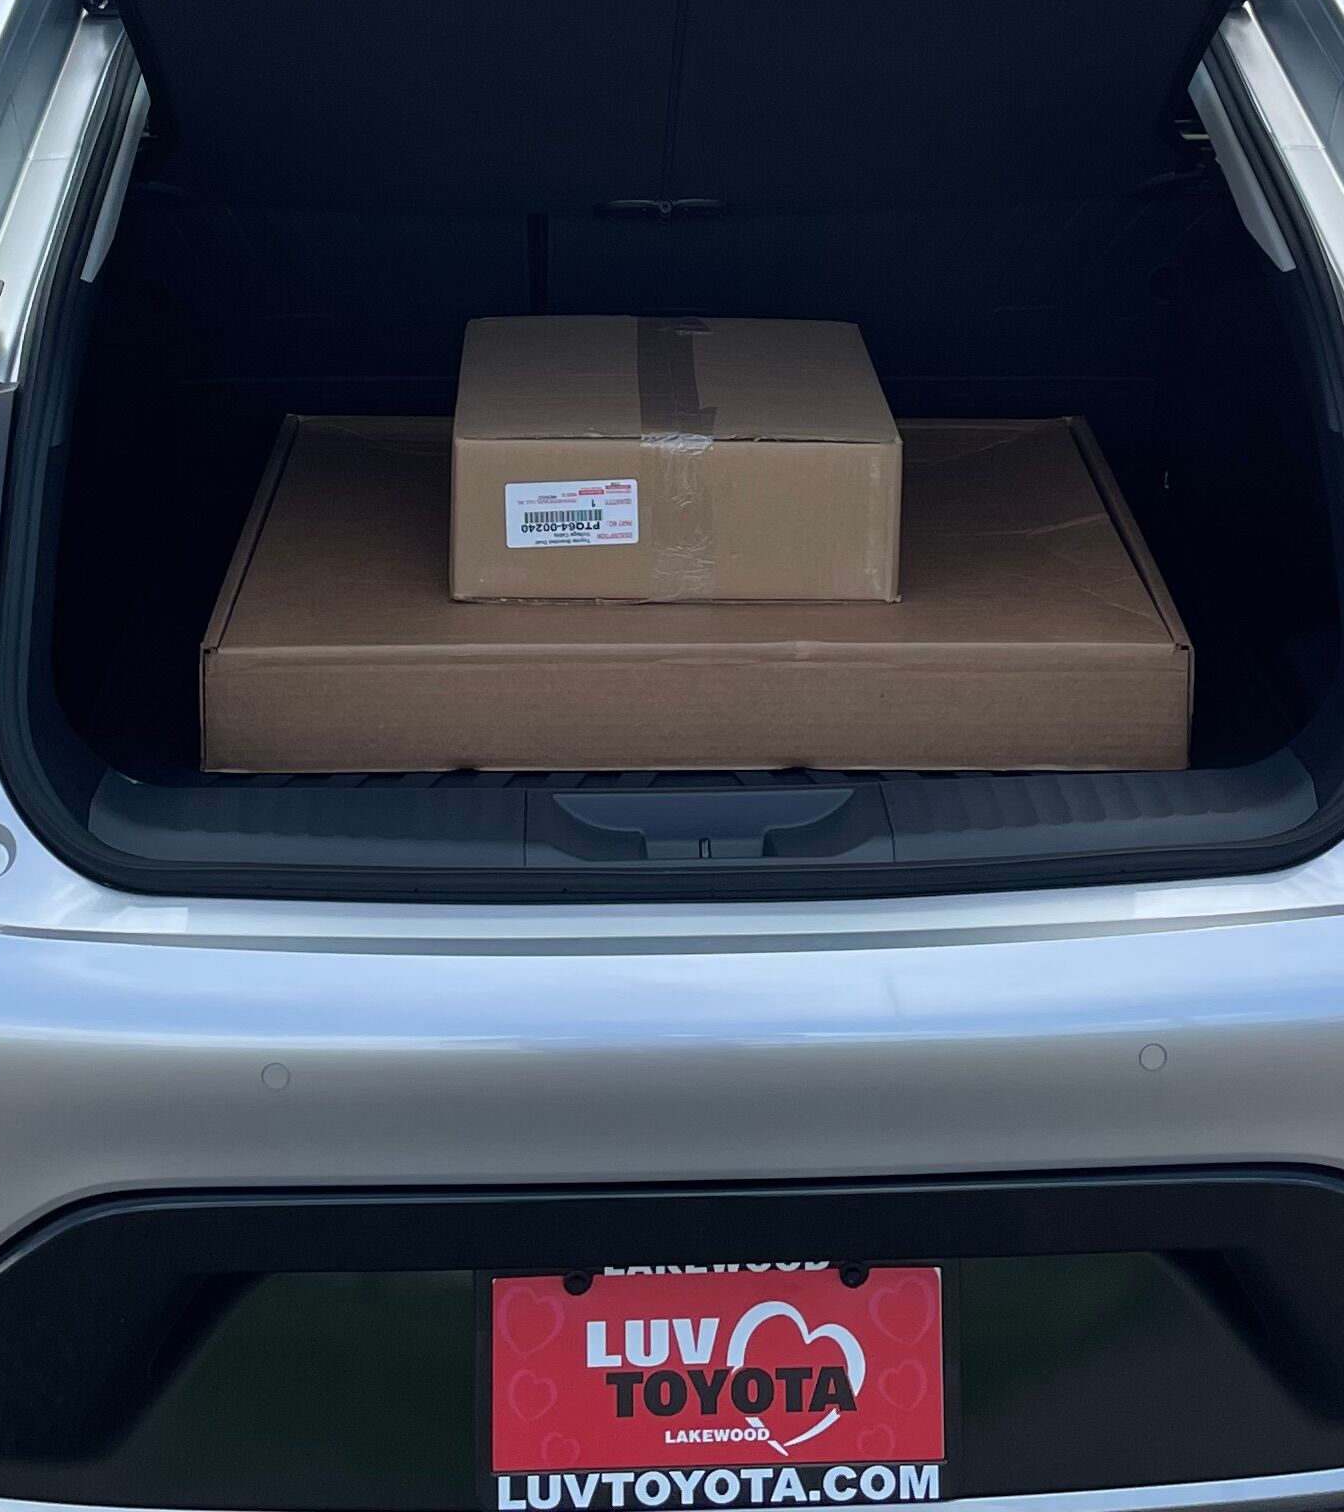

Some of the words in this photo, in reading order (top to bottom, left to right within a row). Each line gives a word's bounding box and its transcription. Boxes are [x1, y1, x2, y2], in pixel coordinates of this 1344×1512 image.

[591, 498, 596, 508] 1
[521, 522, 601, 533] PTQ64-00240
[586, 1317, 720, 1368] LUV
[605, 1366, 857, 1418] TOYOTA
[665, 1426, 771, 1444] LAKEWOOD
[497, 1464, 940, 1511] LUVTOYOTA.COM
